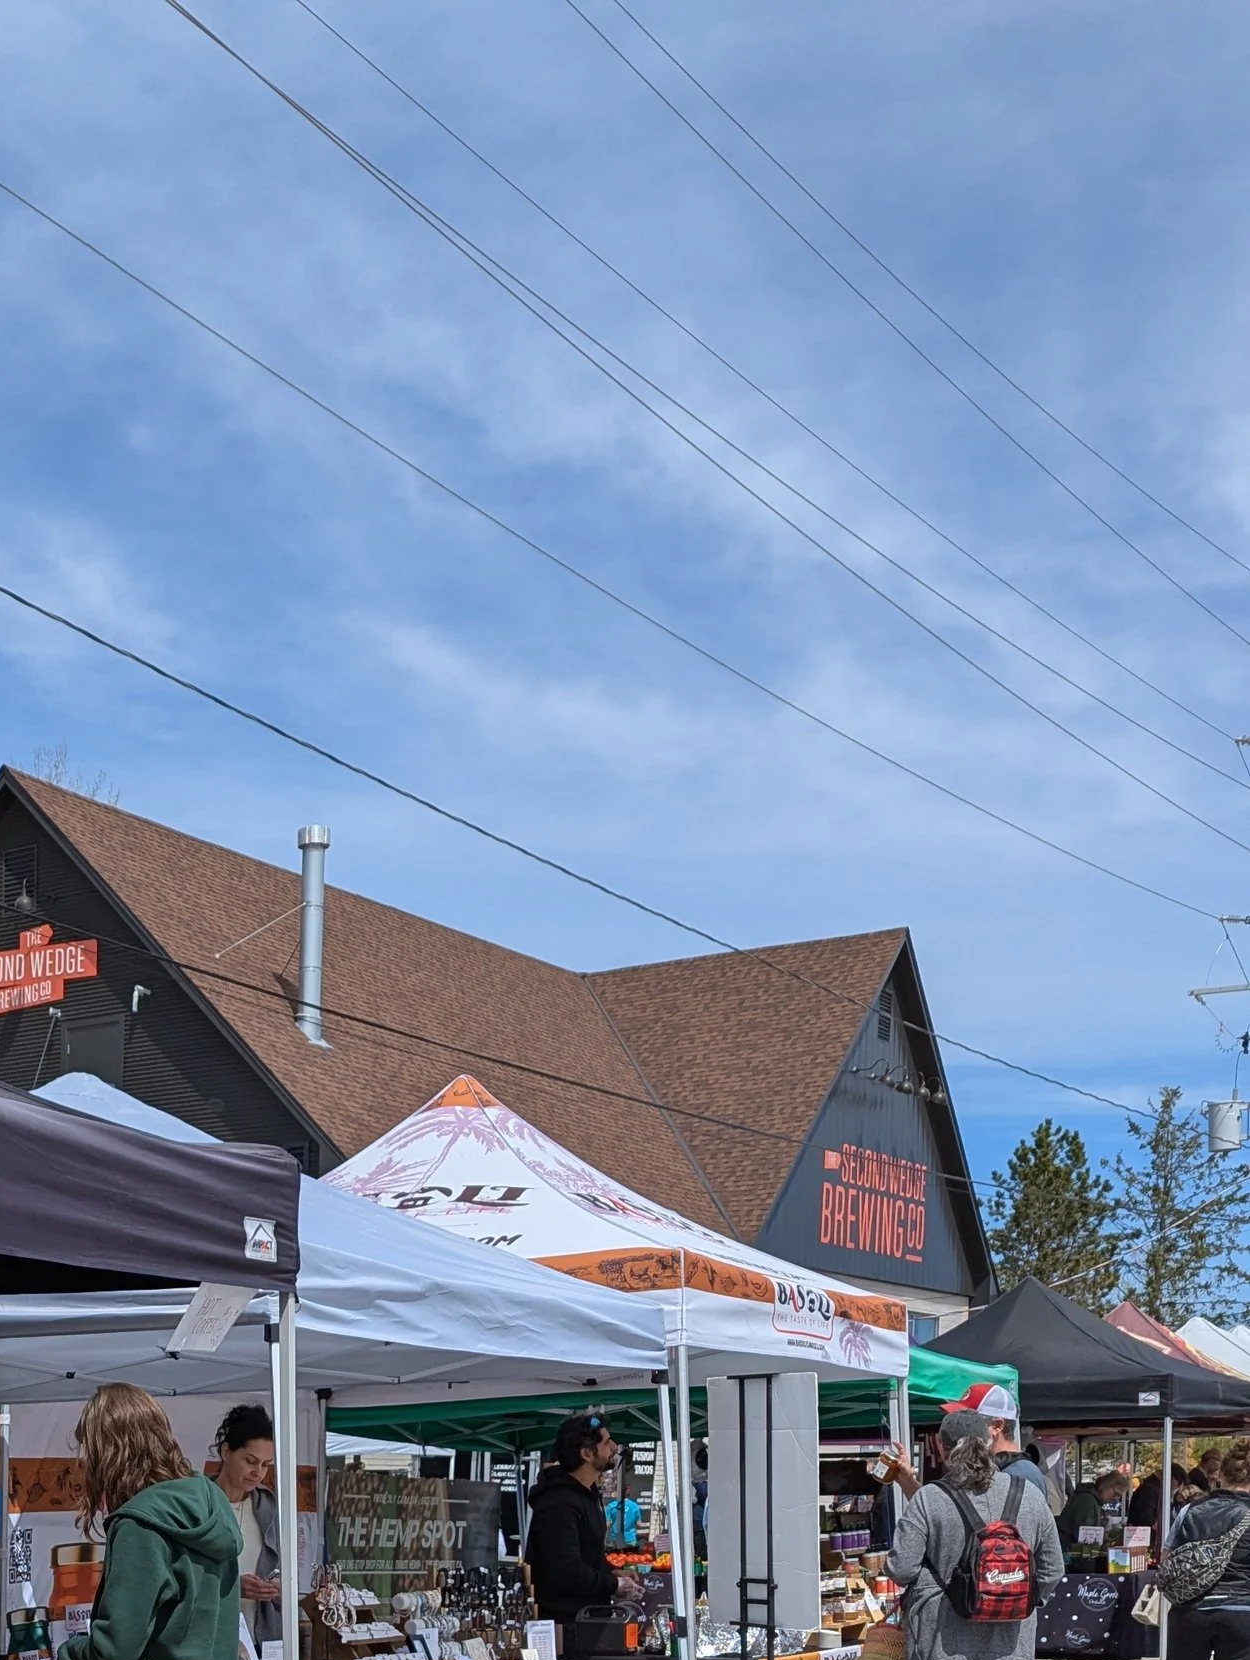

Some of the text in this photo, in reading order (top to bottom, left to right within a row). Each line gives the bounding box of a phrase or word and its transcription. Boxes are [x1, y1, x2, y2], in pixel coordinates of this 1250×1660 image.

[25, 928, 42, 948] THE
[30, 945, 85, 979] WEDGE
[40, 980, 52, 997] CO
[841, 1143, 887, 1191] SECOND
[889, 1155, 927, 1202] WEDGE
[820, 1181, 925, 1259] BREWING CO
[777, 1313, 829, 1331] THE TASTE OF LIFE
[632, 1450, 655, 1462] FUSION
[634, 1464, 654, 1475] TACOS
[338, 1516, 369, 1547] THE
[369, 1518, 421, 1551] HEMP
[421, 1519, 467, 1550] SPOT
[985, 1567, 1026, 1583] Canada
[1077, 1583, 1099, 1600] Maple
